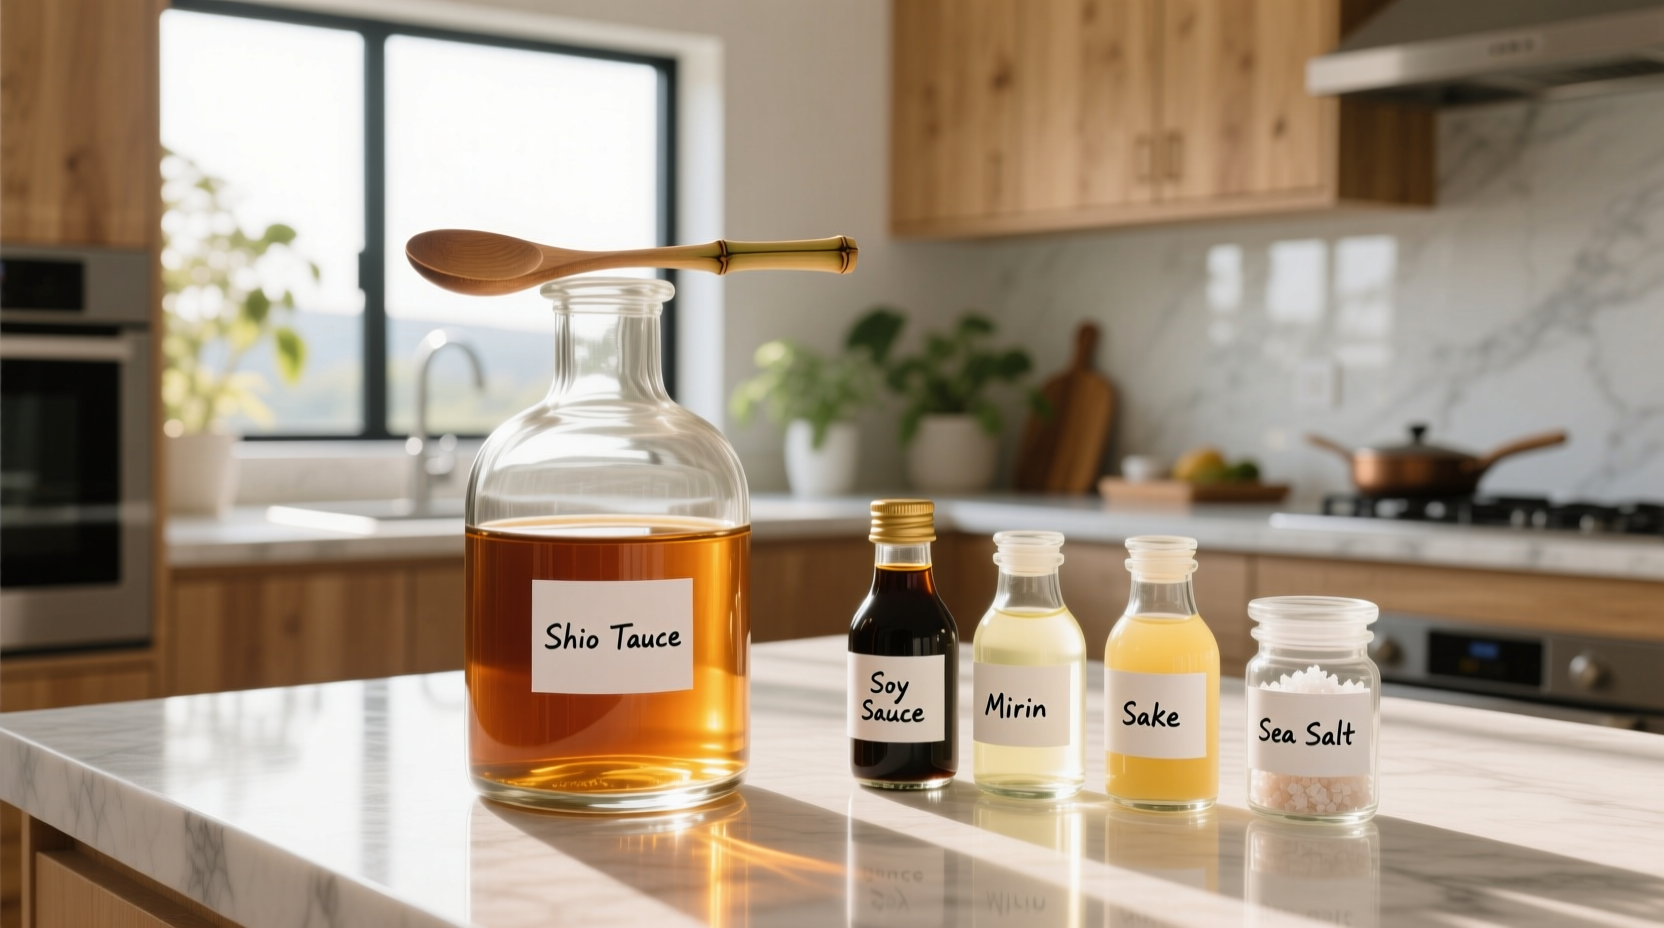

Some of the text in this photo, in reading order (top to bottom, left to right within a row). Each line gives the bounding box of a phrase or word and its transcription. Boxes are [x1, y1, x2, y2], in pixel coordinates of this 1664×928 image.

[544, 622, 682, 651] Shio Tauce
[870, 670, 910, 705] Soy
[861, 698, 925, 723] Sauce
[984, 692, 1046, 719] Mirin
[1122, 700, 1181, 728] Sake
[1258, 717, 1356, 747] Sea Salt
